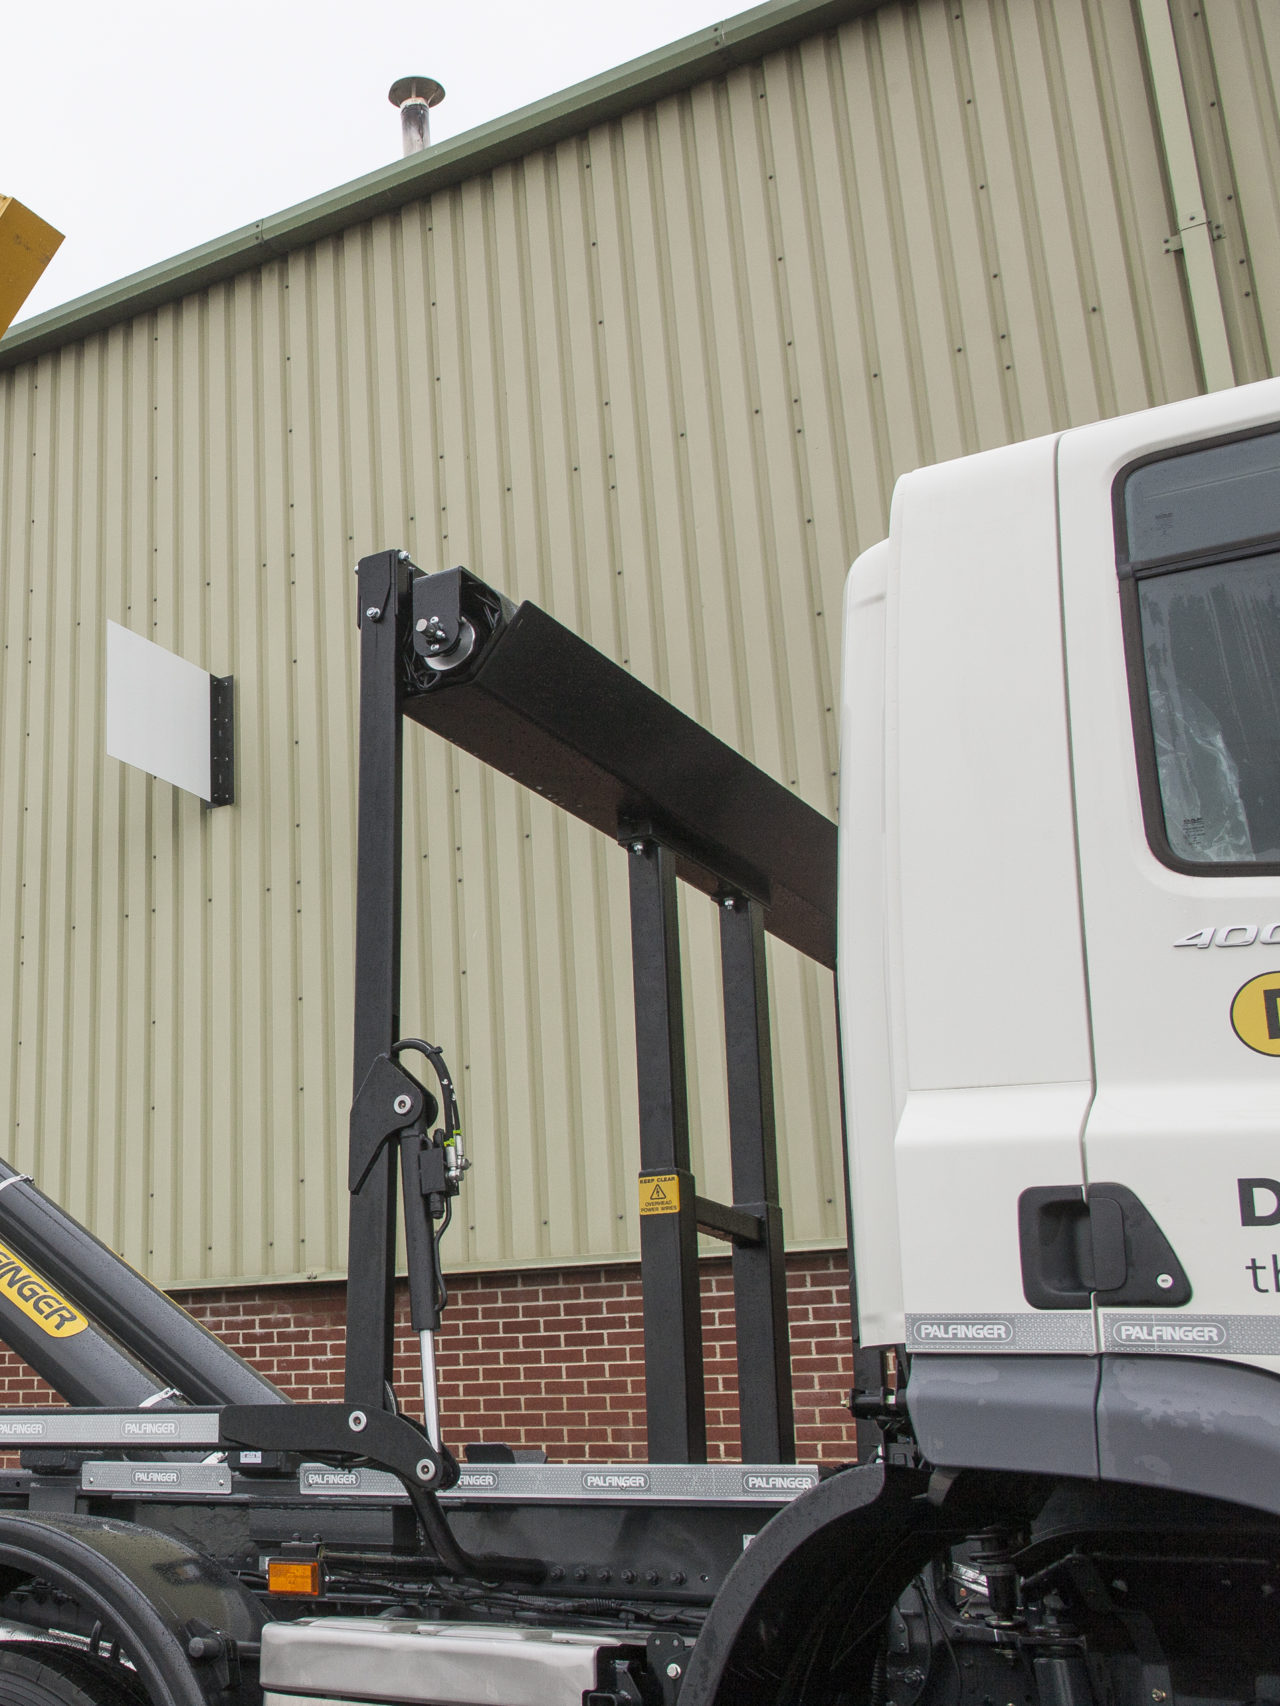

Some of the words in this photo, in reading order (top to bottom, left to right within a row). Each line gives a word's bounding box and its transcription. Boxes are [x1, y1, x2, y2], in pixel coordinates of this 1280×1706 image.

[920, 1325, 1007, 1339] PALFINGER
[1120, 1326, 1219, 1342] PALFINGER
[124, 1423, 176, 1434] PALFINGER
[135, 1472, 178, 1482] PALFINGER
[308, 1474, 357, 1485] PALFINGER
[459, 1475, 494, 1486] FINGER
[586, 1476, 646, 1487] PALFINGER
[748, 1476, 813, 1489] PALFINGER
